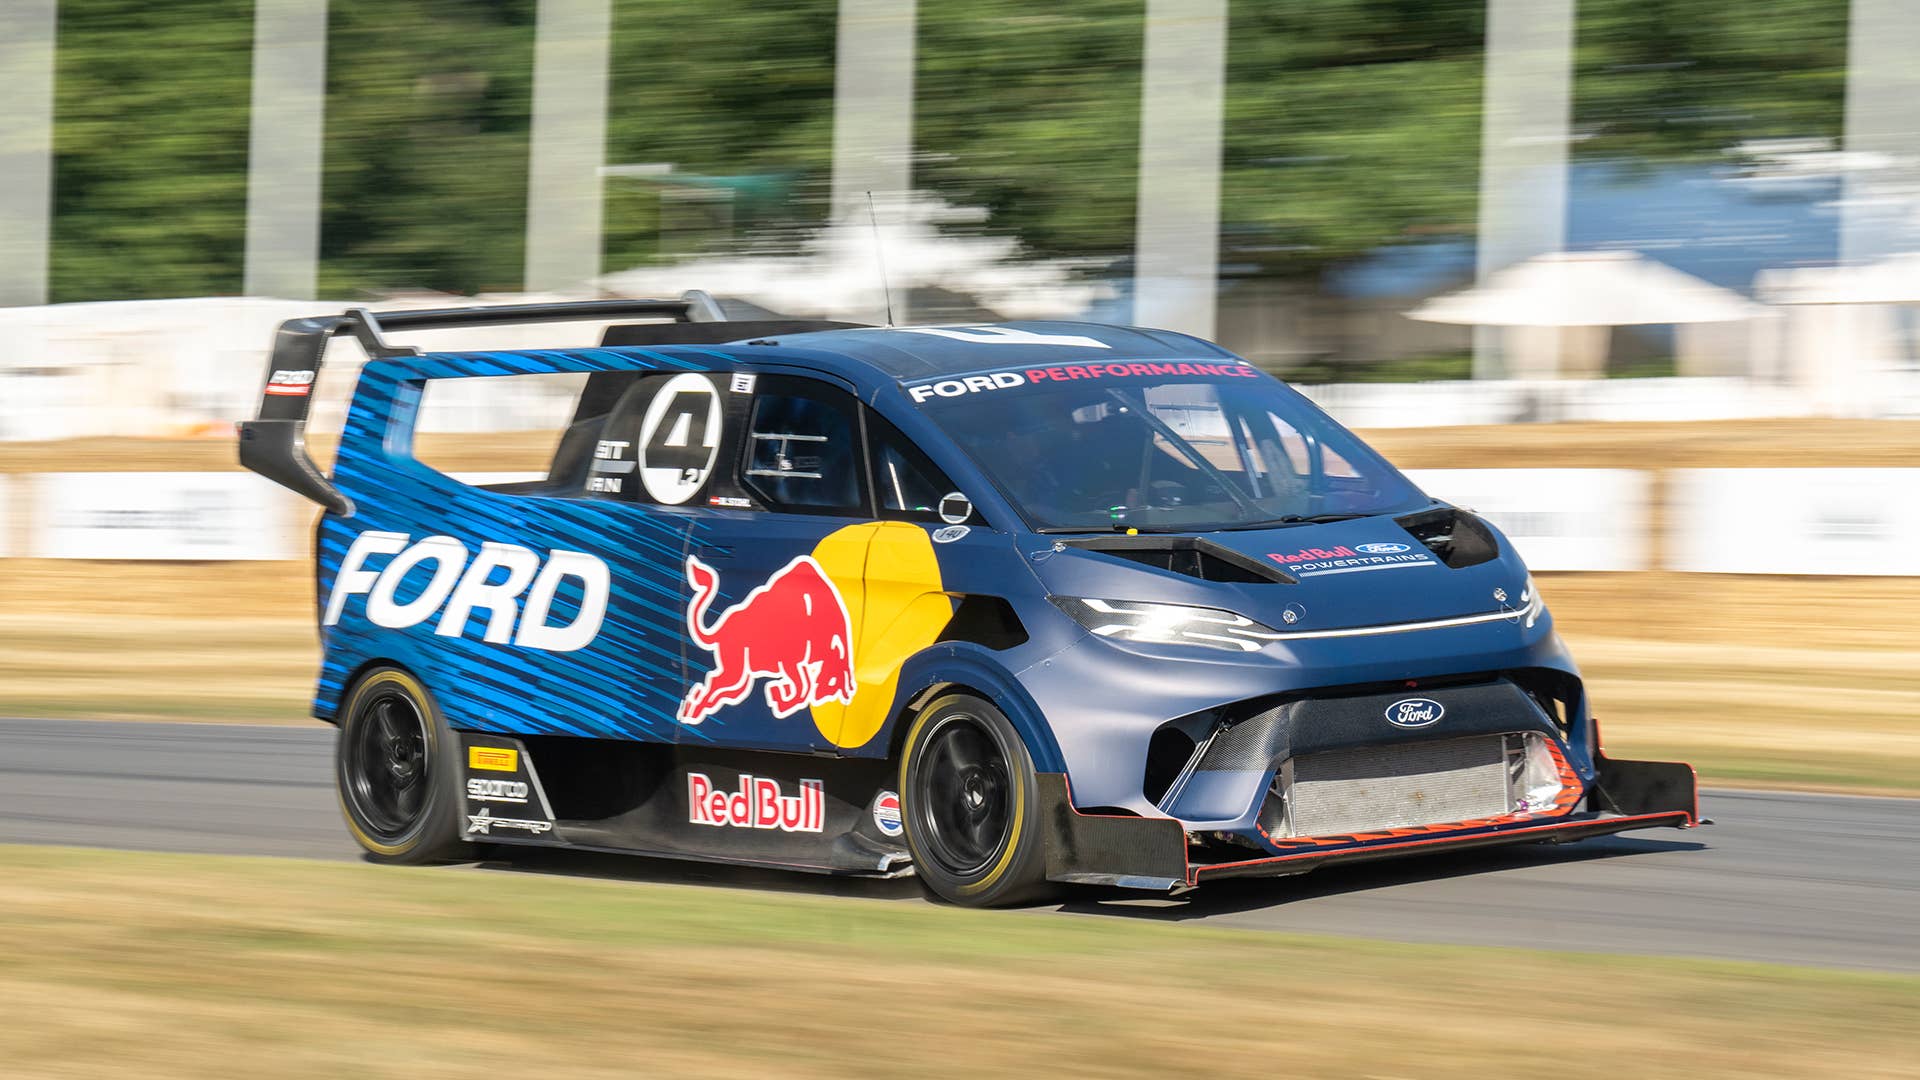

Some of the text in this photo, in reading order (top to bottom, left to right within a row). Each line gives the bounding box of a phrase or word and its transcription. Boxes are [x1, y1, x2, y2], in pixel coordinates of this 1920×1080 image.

[908, 362, 1260, 404] FORD PERFORMANCE
[1288, 553, 1430, 572] POWERTRAINS
[322, 530, 611, 652] FORD
[1397, 702, 1434, 723] Ford
